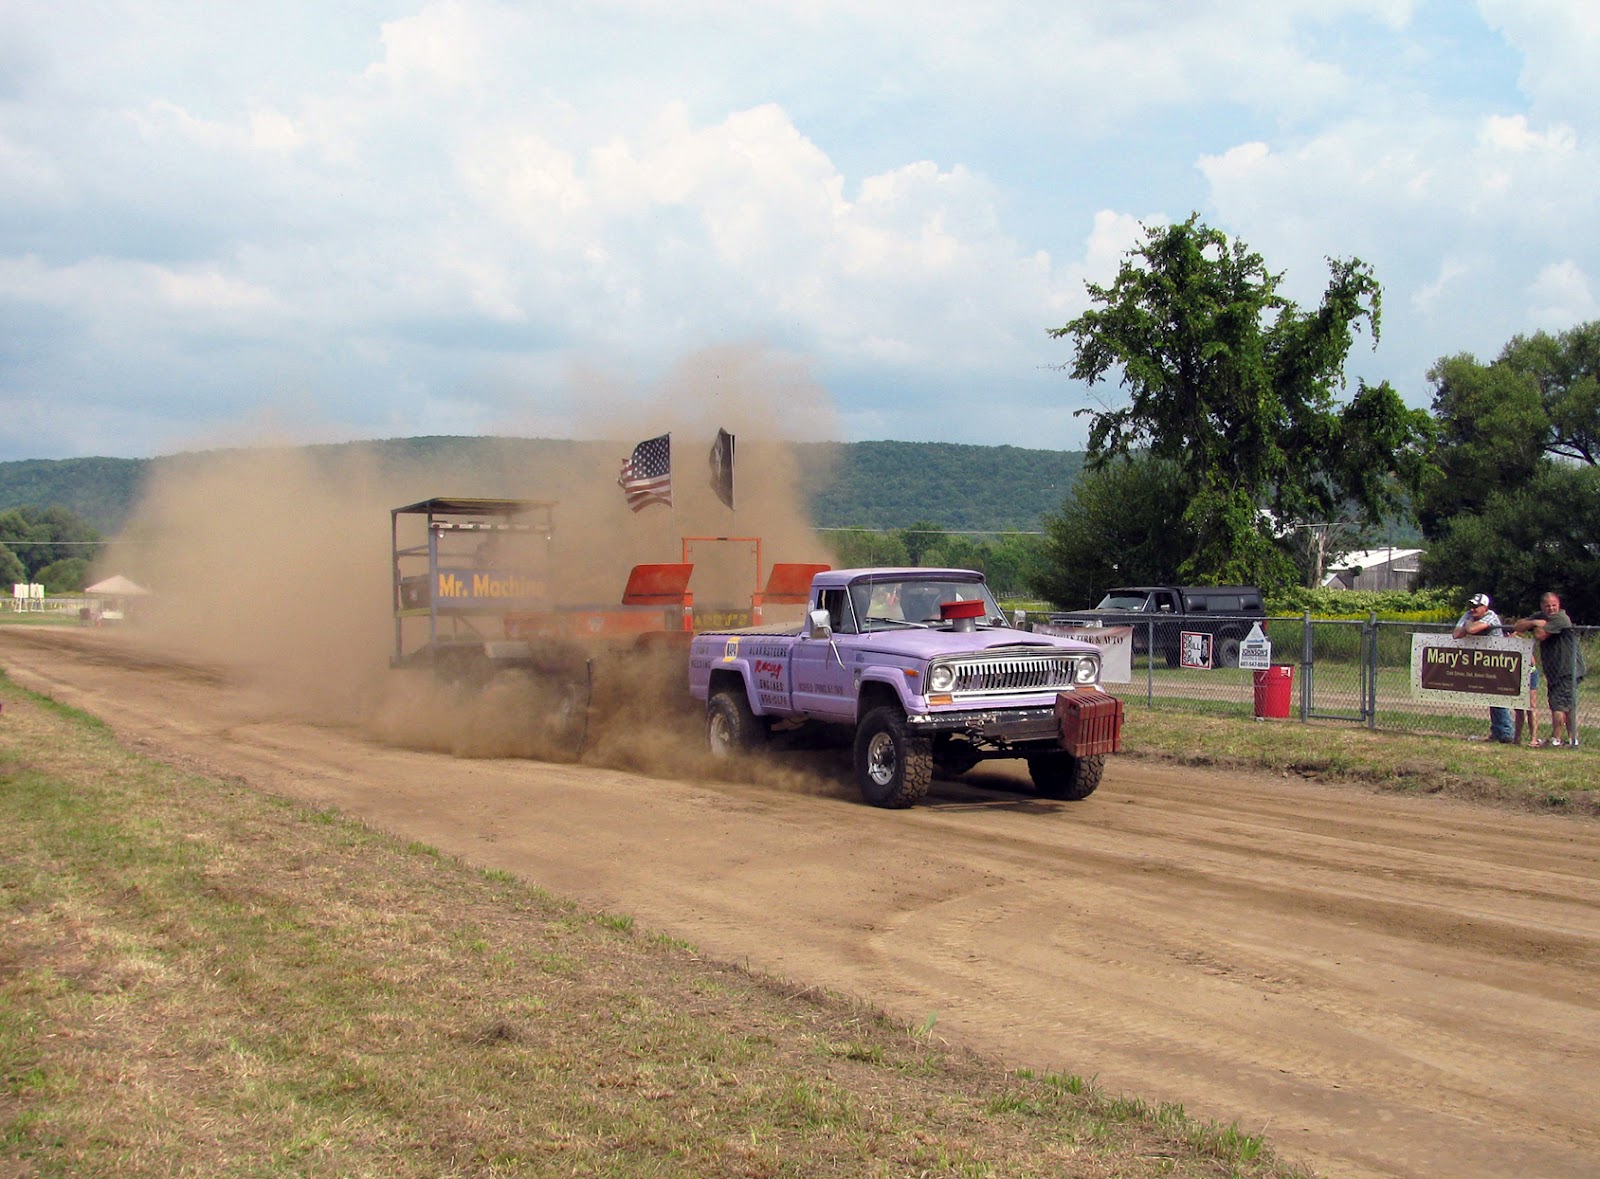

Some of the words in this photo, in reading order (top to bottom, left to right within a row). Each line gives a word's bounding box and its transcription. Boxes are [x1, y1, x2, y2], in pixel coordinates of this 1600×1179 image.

[439, 573, 468, 597] Mr.
[1095, 636, 1101, 644] &
[1104, 636, 1124, 645] AUTO
[1427, 648, 1470, 667] Mary's
[1473, 650, 1519, 672] Pantry
[760, 679, 784, 692] ENGINES
